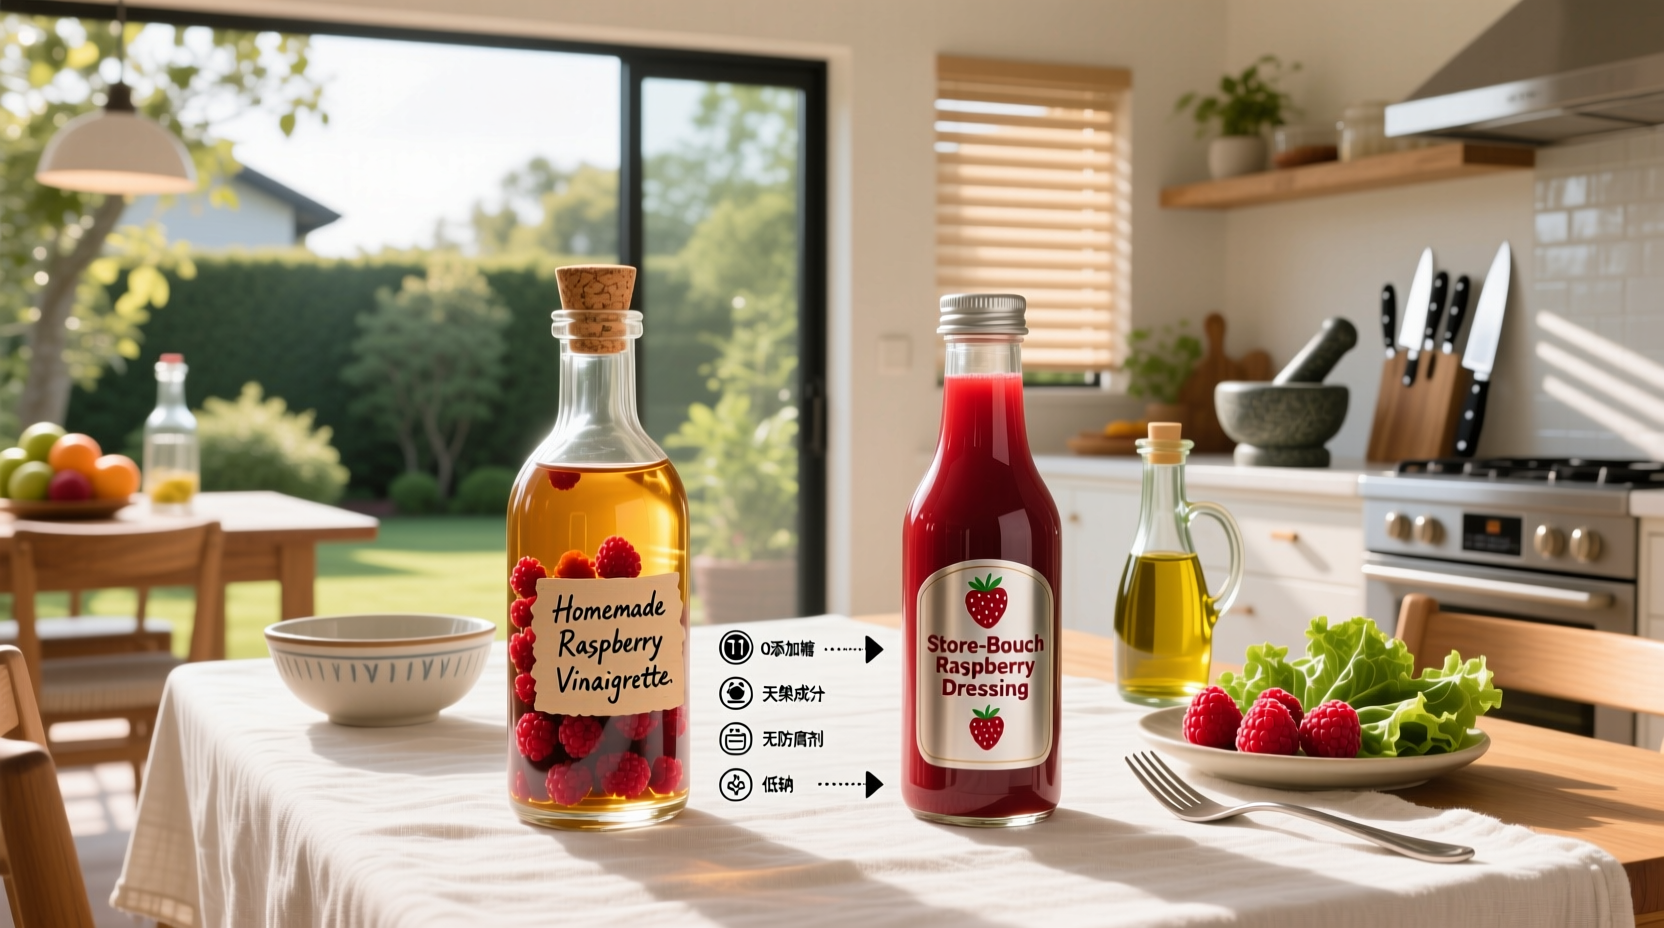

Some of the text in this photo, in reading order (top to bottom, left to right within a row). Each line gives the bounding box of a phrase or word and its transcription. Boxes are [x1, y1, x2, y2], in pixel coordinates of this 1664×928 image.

[552, 590, 666, 623] Homemade
[558, 628, 663, 665] Raspberry
[927, 634, 1045, 654] Store-Bouch
[936, 656, 1035, 679] Raspberry
[942, 679, 1029, 700] Dressing
